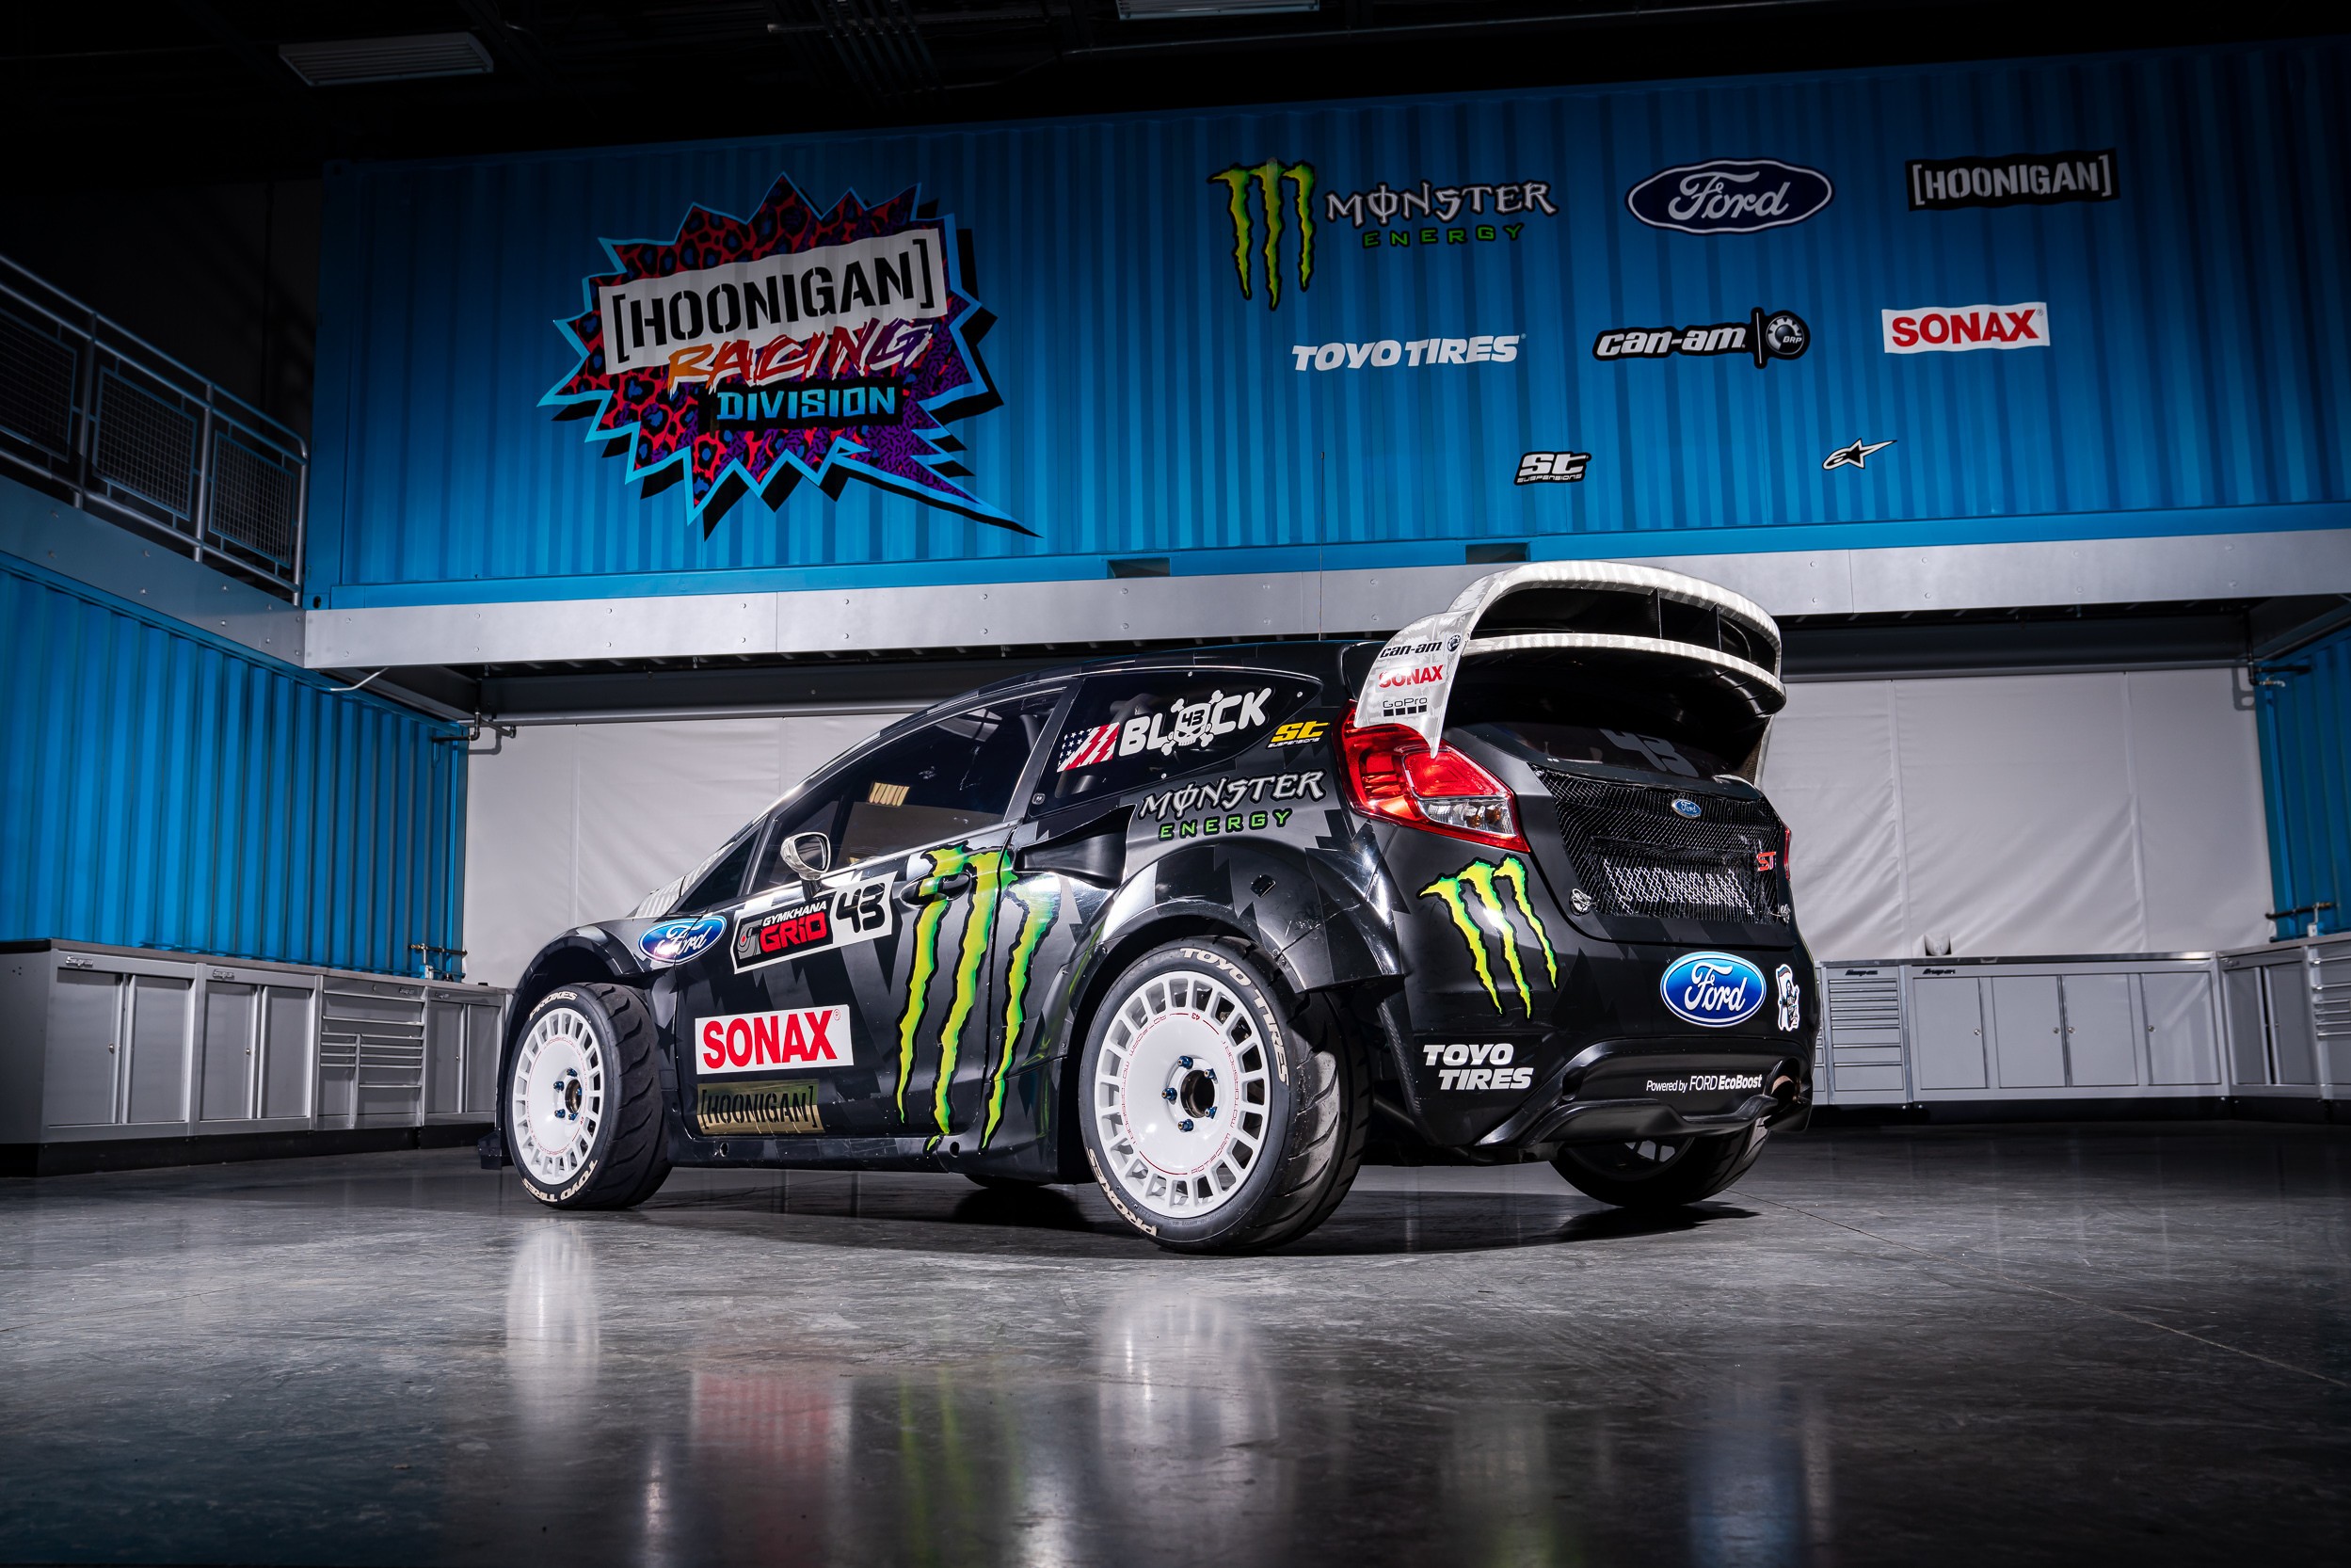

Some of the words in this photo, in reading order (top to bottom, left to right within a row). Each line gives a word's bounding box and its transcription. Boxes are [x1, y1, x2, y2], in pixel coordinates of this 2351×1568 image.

[1668, 169, 1791, 220] Ford
[1912, 154, 2113, 205] [HOONIGAN]
[1365, 224, 1524, 247] ENERGY
[613, 238, 936, 363] [HOONIGAN]
[1783, 335, 1802, 344] BRP
[1892, 308, 2040, 347] SONAX
[667, 317, 934, 395] RACING
[1292, 339, 1402, 372] TOYO
[1405, 335, 1520, 367] TIRES
[716, 386, 896, 421] DIVISION
[1182, 710, 1205, 728] 43
[1383, 697, 1428, 709] GoPro
[1680, 800, 1697, 814] Ford
[1160, 810, 1290, 839] ENERGY
[1757, 852, 1777, 872] ST
[762, 901, 827, 927] GYMKHANA
[836, 882, 886, 934] 43
[1684, 963, 1746, 1013] Ford
[529, 991, 578, 1021] PROXES
[1179, 947, 1252, 986] TOYO
[1253, 988, 1289, 1085] TIRES
[703, 1010, 838, 1069] SONAX
[1422, 1043, 1514, 1066] TOYO
[1438, 1067, 1534, 1090] TIRES
[1646, 1080, 1679, 1092] Powered
[1678, 1080, 1687, 1093] by
[1689, 1075, 1718, 1091] FORD
[1718, 1074, 1763, 1090] EcoBoost
[522, 1177, 558, 1203] TIRES
[560, 1160, 599, 1200] TOYO
[1086, 1146, 1157, 1237] PROXES
